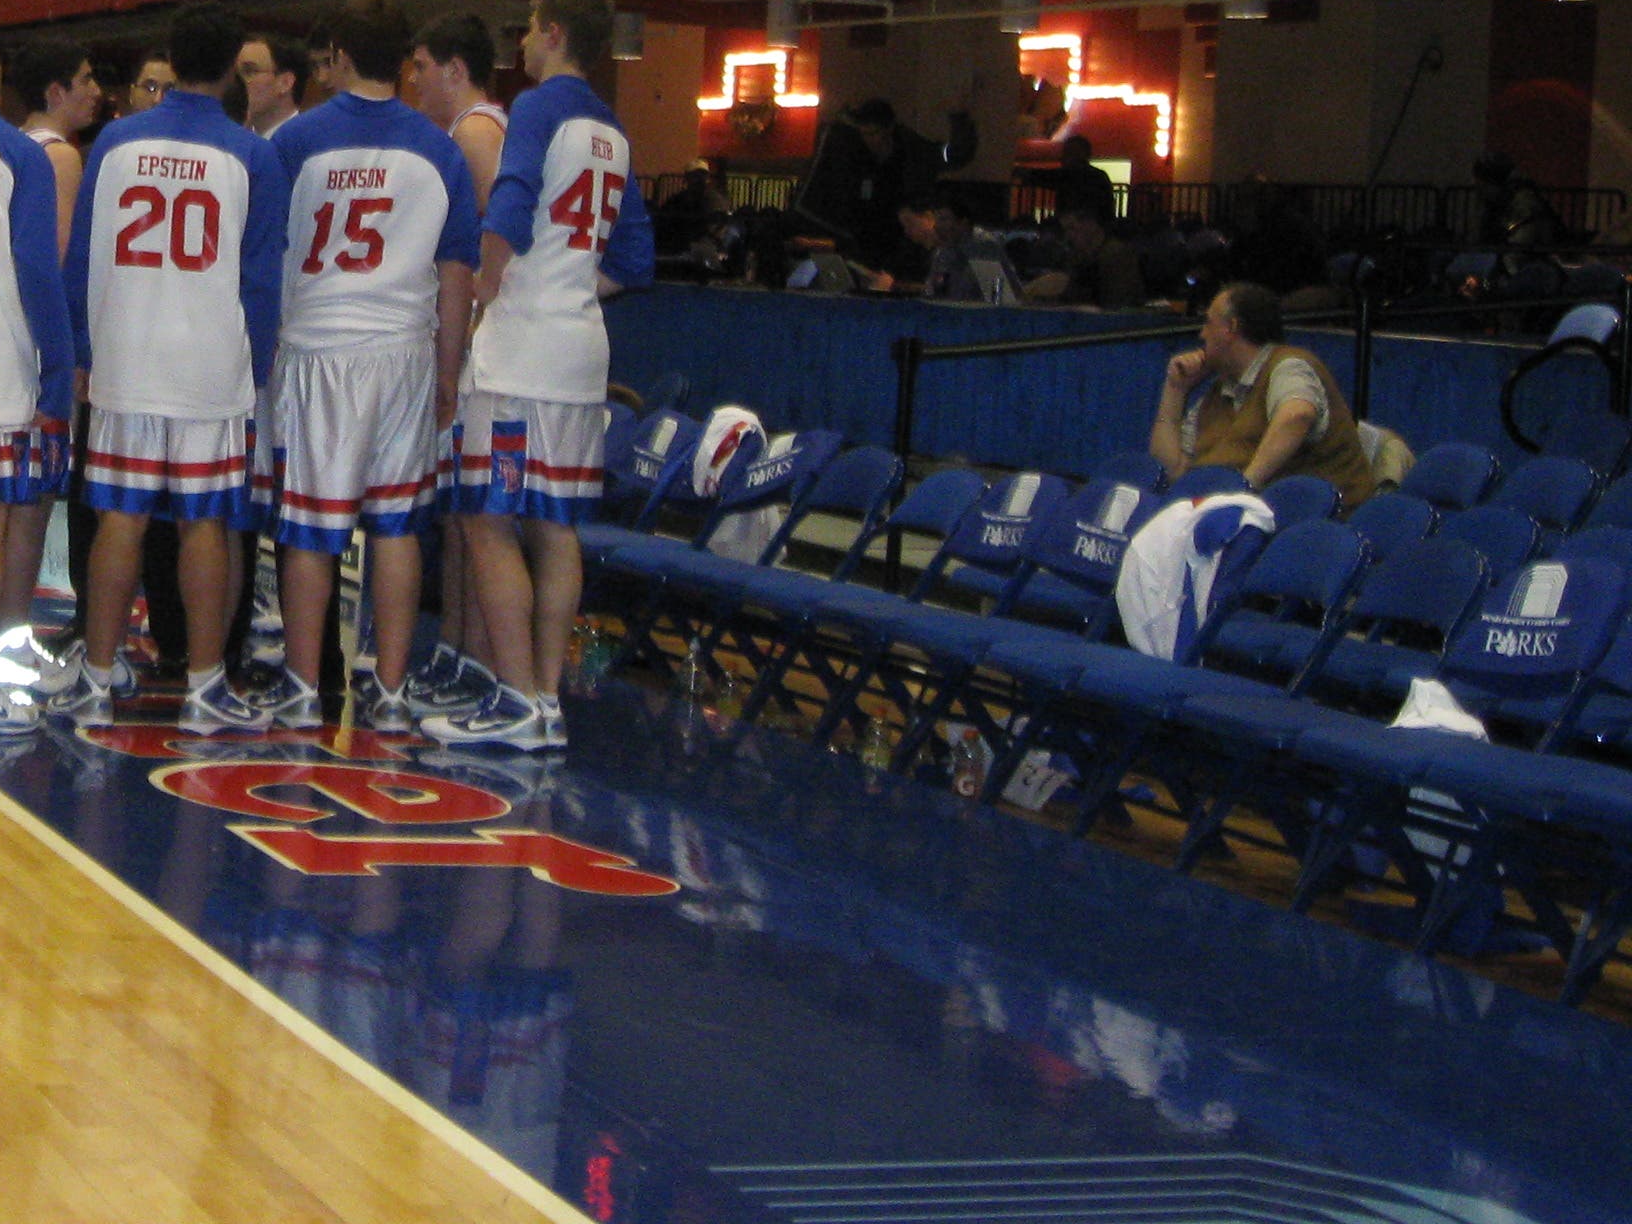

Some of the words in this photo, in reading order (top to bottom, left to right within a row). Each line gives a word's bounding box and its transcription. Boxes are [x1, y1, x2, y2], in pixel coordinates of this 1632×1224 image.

[137, 154, 206, 182] EPSTEIN
[326, 166, 387, 191] BENSON
[114, 185, 221, 273] 20
[299, 197, 394, 275] 15
[549, 167, 626, 255] 45
[1483, 627, 1559, 658] PARKS
